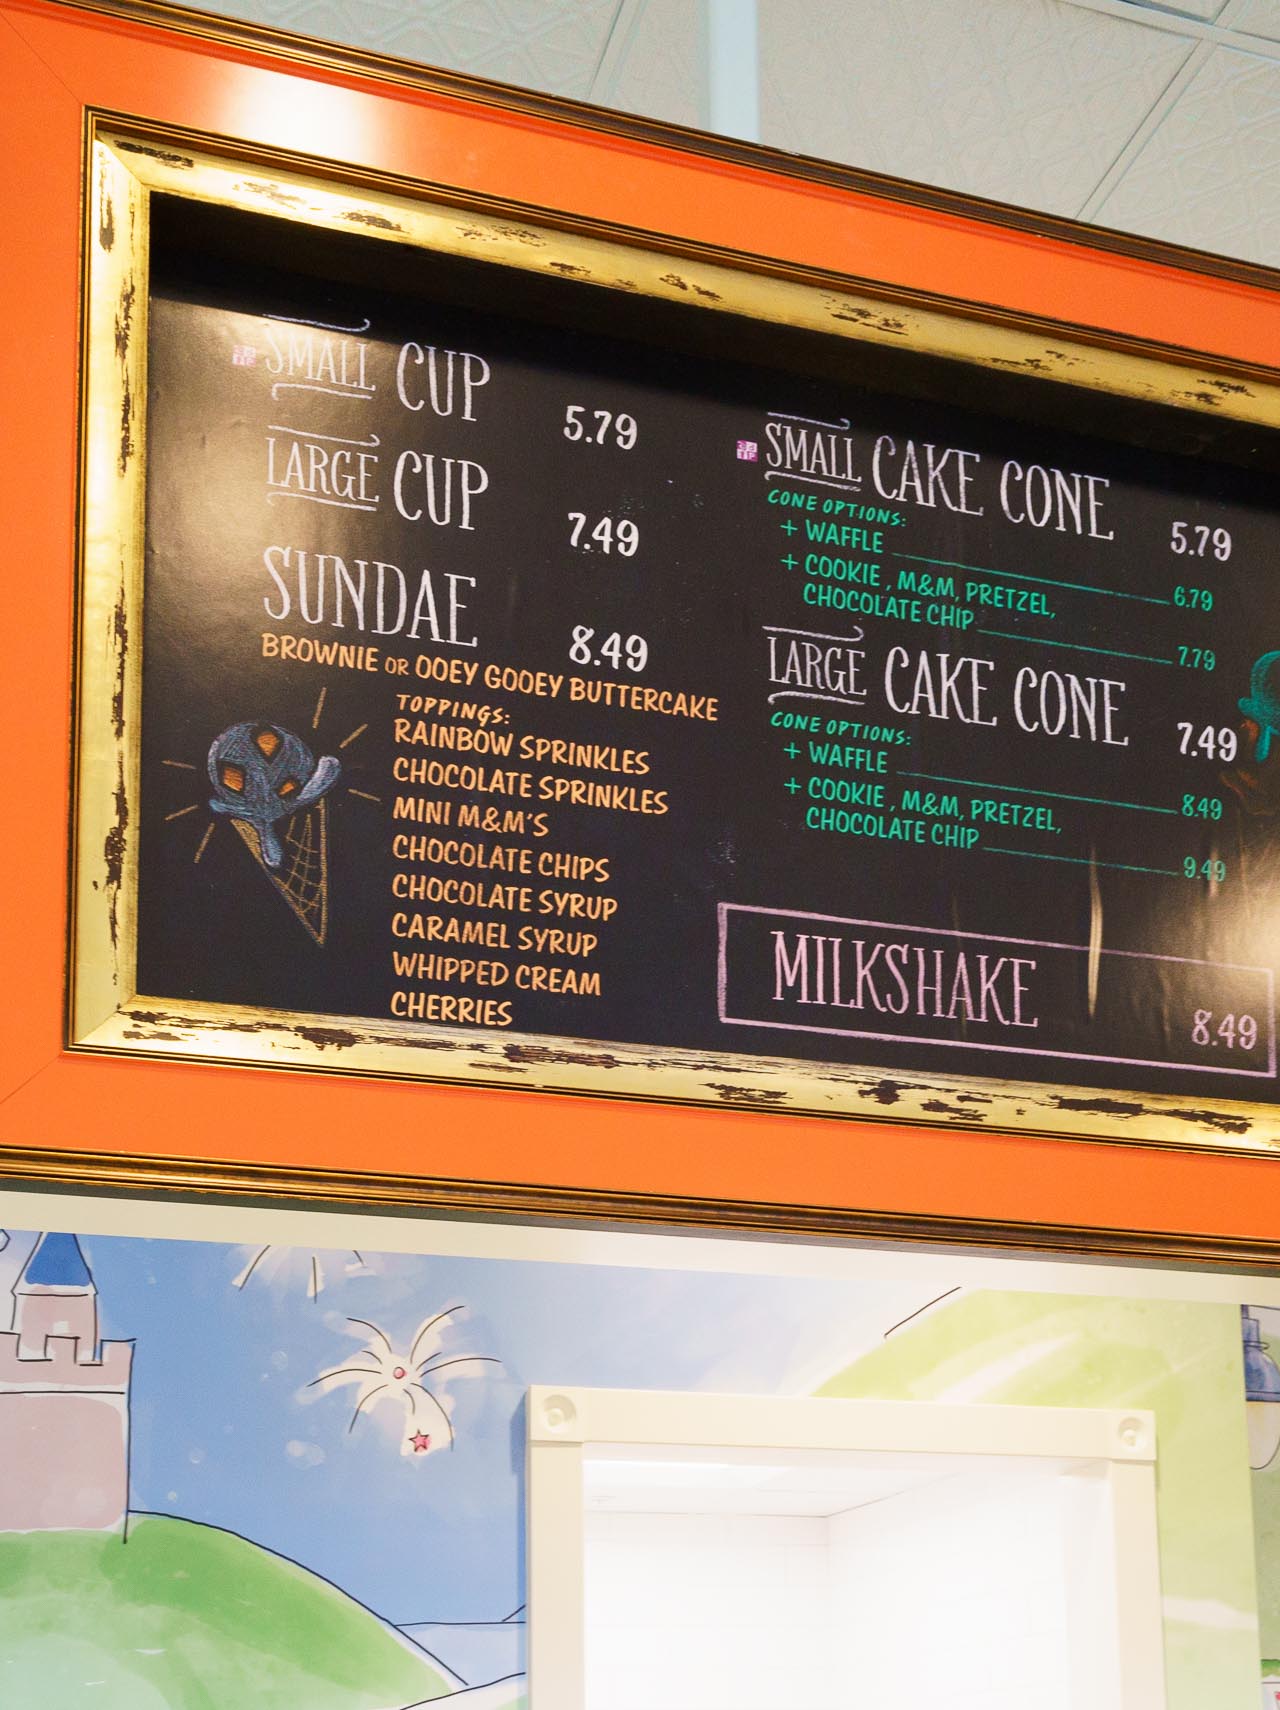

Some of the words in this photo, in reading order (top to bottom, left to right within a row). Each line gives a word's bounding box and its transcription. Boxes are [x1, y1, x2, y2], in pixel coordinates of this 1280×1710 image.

[266, 329, 375, 392] SMALL
[396, 342, 491, 422] CUP
[563, 405, 638, 450] 5.79
[266, 437, 379, 503] LARGE
[393, 450, 489, 531] CUP
[567, 512, 640, 557] 7.49
[764, 423, 862, 482] SMALL
[872, 435, 984, 518] CAKE
[1000, 460, 1114, 541] CONE
[1170, 521, 1232, 561] 5.79
[768, 489, 817, 510] CONE
[824, 498, 907, 527] OPTIONS:
[805, 520, 884, 554] WAFFLE
[1173, 586, 1214, 612] 6.79
[263, 546, 478, 647] SUNDAE
[569, 624, 649, 673] 8.49
[897, 571, 961, 601] M&M,
[966, 582, 1057, 620] PRETZEL,
[803, 583, 922, 624] CHOCOLATE
[926, 604, 975, 631] CHIP
[1177, 646, 1216, 672] 7.79
[261, 633, 379, 672] BROWNIE
[415, 655, 480, 686] OOEY
[484, 665, 564, 698] GOOEY
[569, 677, 719, 722] BUTTERCAKE
[768, 635, 867, 697] LARGE
[885, 646, 998, 728] CAKE
[1013, 666, 1129, 747] CONE
[1176, 722, 1238, 763] 7.49
[396, 694, 511, 726] TOPPINGS:
[770, 711, 821, 732] CONE
[827, 719, 912, 746] OPTIONS:
[394, 719, 514, 757] RAINBOW
[519, 736, 651, 775] SPRINKLES
[393, 758, 532, 799] CHOCOLATE
[538, 776, 670, 815] SPRINKLES
[808, 742, 888, 775] WAFFLE
[1182, 794, 1223, 821] 8.49
[393, 797, 451, 826] MINI
[457, 806, 550, 837] M&M'S
[901, 791, 966, 822] M&M,
[970, 799, 1063, 834] PRETZEL,
[392, 835, 533, 875] CHOCOLATE
[538, 852, 611, 883] CHIPS
[806, 806, 925, 844] CHOCOLATE
[931, 824, 980, 850] CHIP
[1182, 856, 1226, 883] 9.49
[392, 874, 533, 914] CHOCOLATE
[538, 892, 618, 922] SYRUP
[391, 913, 513, 949] CARAMEL
[517, 928, 598, 958] SYRUP
[392, 951, 508, 987] WHIPPED
[515, 966, 601, 997] CREAM
[770, 930, 1039, 1028] MILKSHAKE
[1191, 1009, 1258, 1051] 8.49
[390, 991, 513, 1027] CHERRIES
